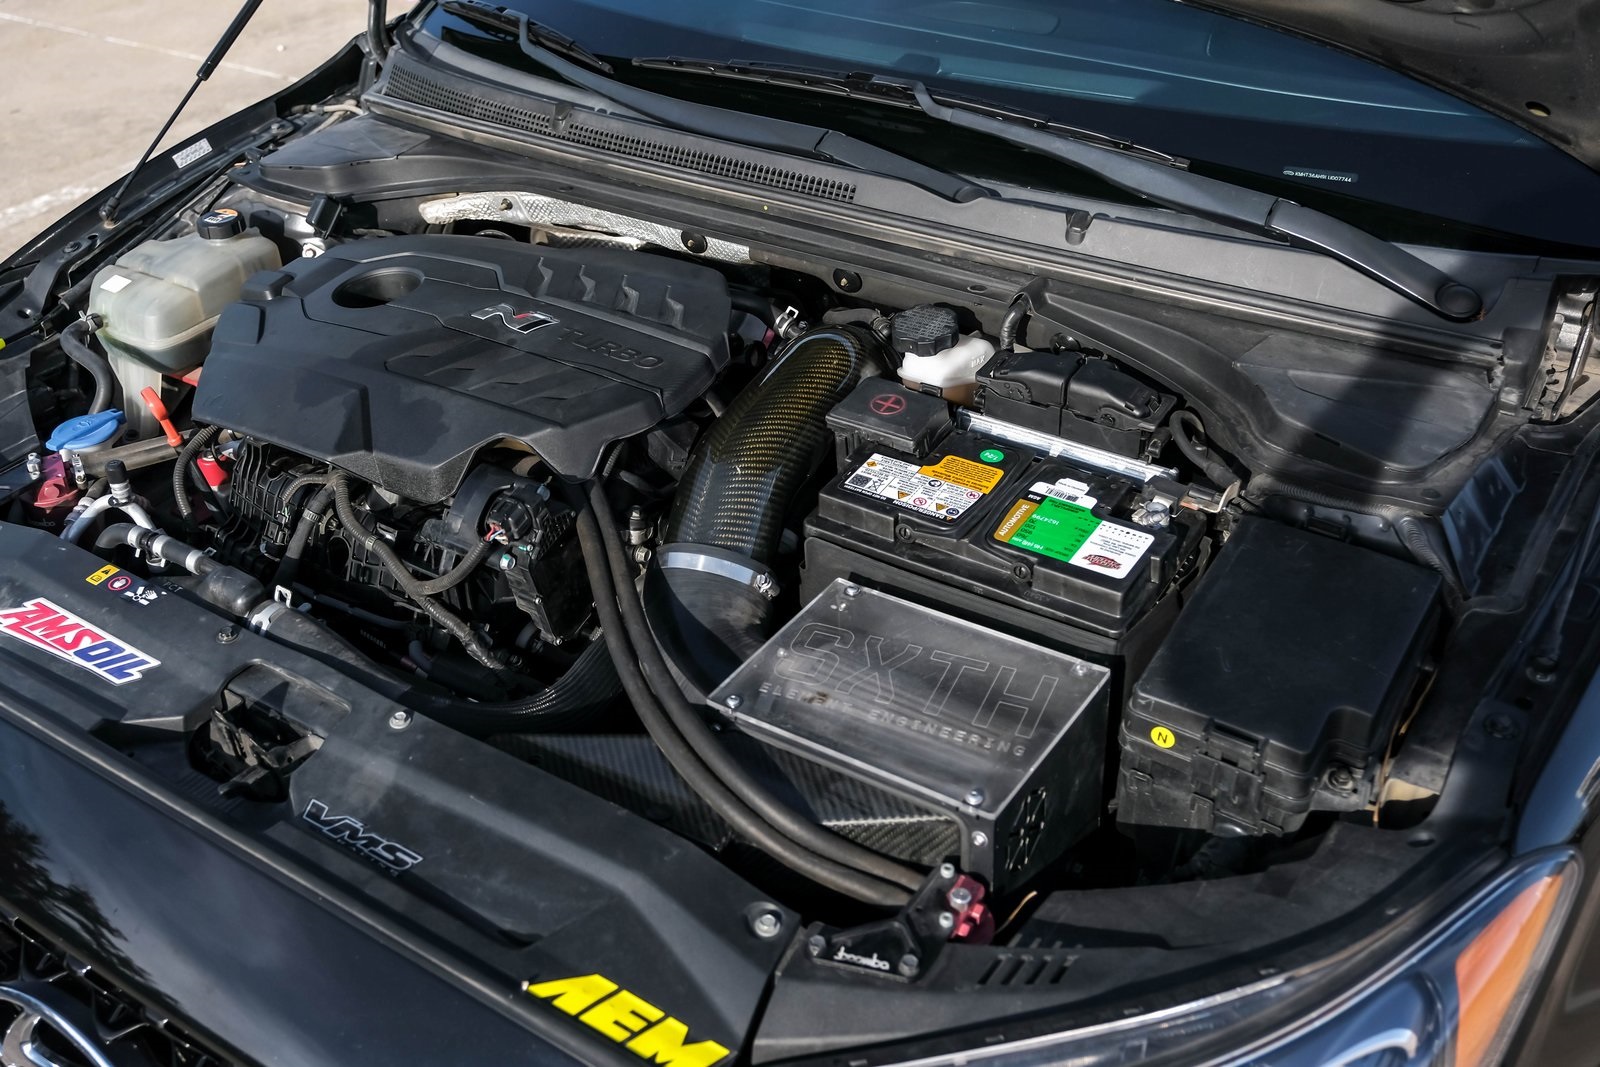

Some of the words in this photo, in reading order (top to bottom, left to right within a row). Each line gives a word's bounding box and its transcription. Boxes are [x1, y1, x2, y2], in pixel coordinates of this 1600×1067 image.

[558, 328, 665, 369] TURBO
[892, 499, 945, 519] DANGER/POISON
[999, 504, 1030, 536] AUTOMOTIVE
[1032, 514, 1060, 526] 1624799
[0, 602, 151, 680] AMSOIL
[774, 622, 1059, 738] SXTH
[758, 681, 857, 715] ELEMENT
[868, 709, 1026, 758] ENGINEERING
[302, 798, 424, 871] VMS
[527, 973, 731, 1067] AEM
